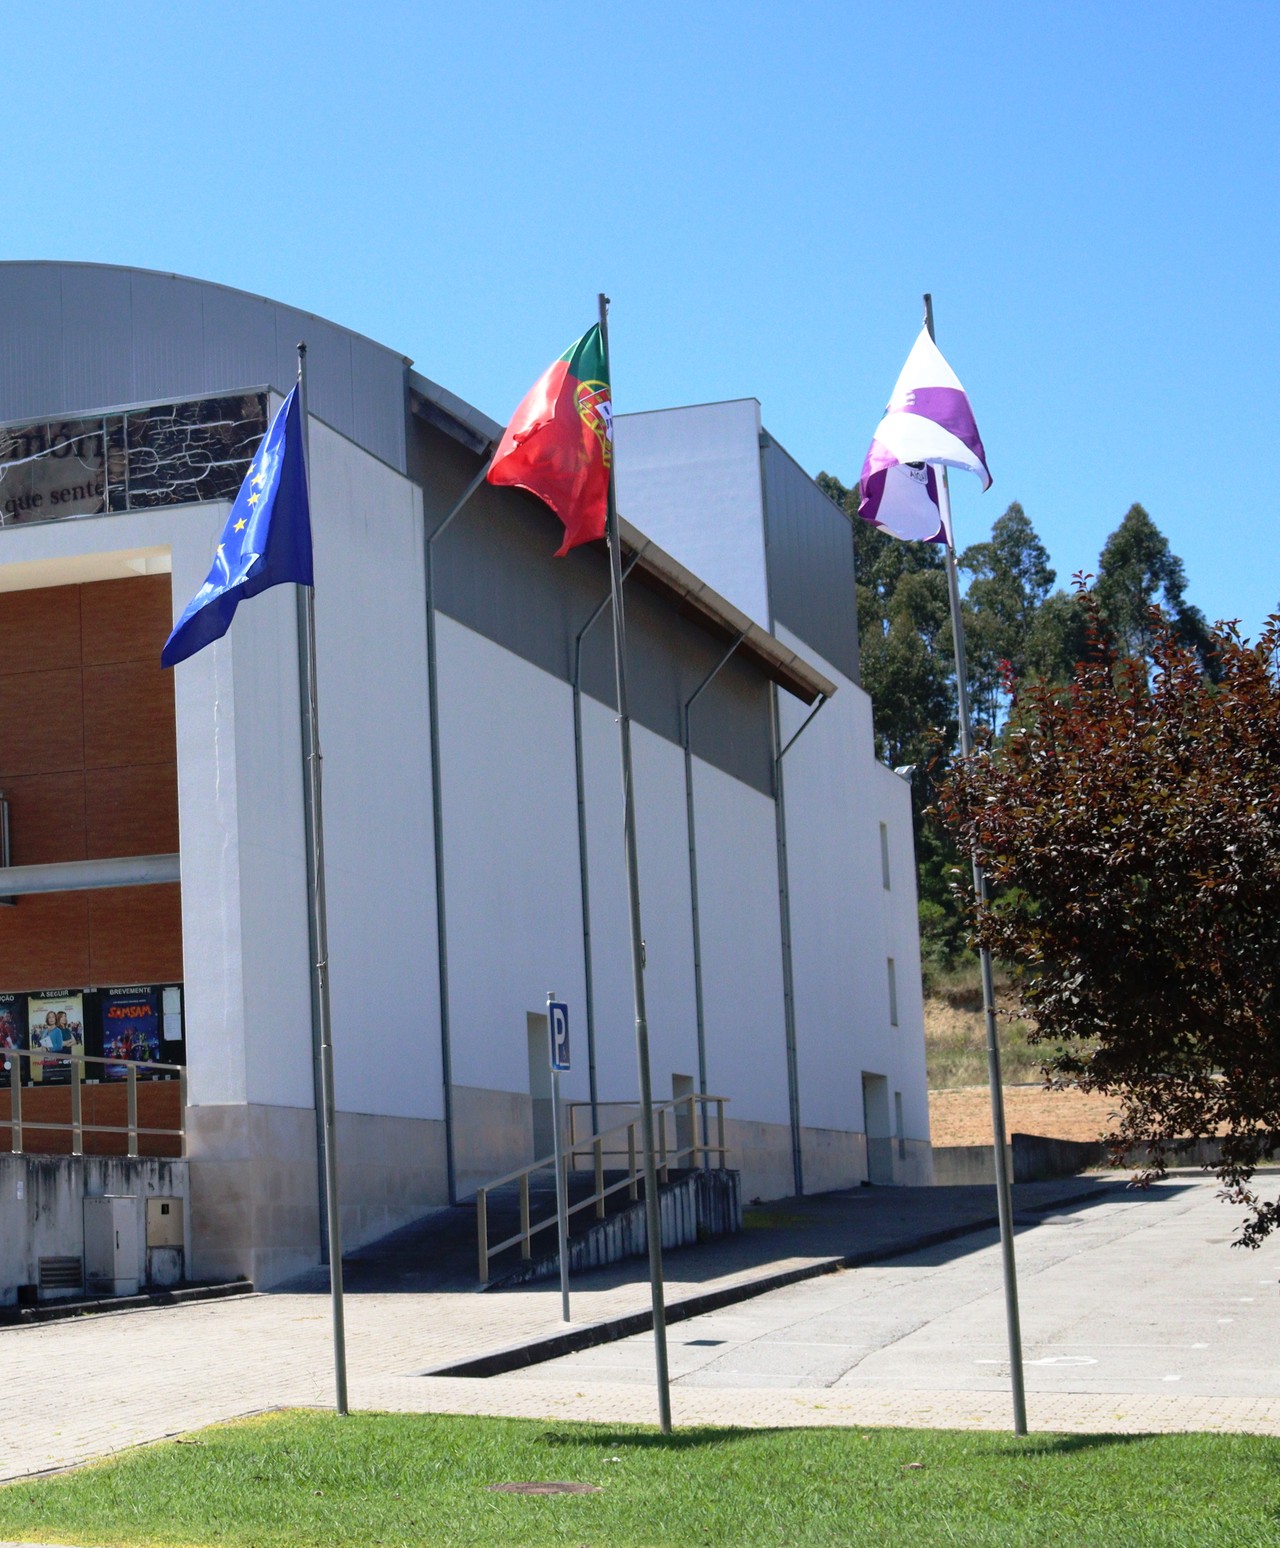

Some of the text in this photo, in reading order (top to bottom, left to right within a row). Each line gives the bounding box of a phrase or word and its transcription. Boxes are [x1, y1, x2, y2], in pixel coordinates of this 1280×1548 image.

[4, 492, 43, 519] que
[46, 990, 69, 998] SEGUIR
[109, 986, 152, 996] BREVEMENTE
[107, 1003, 153, 1019] SAMSAM
[553, 1008, 566, 1065] P
